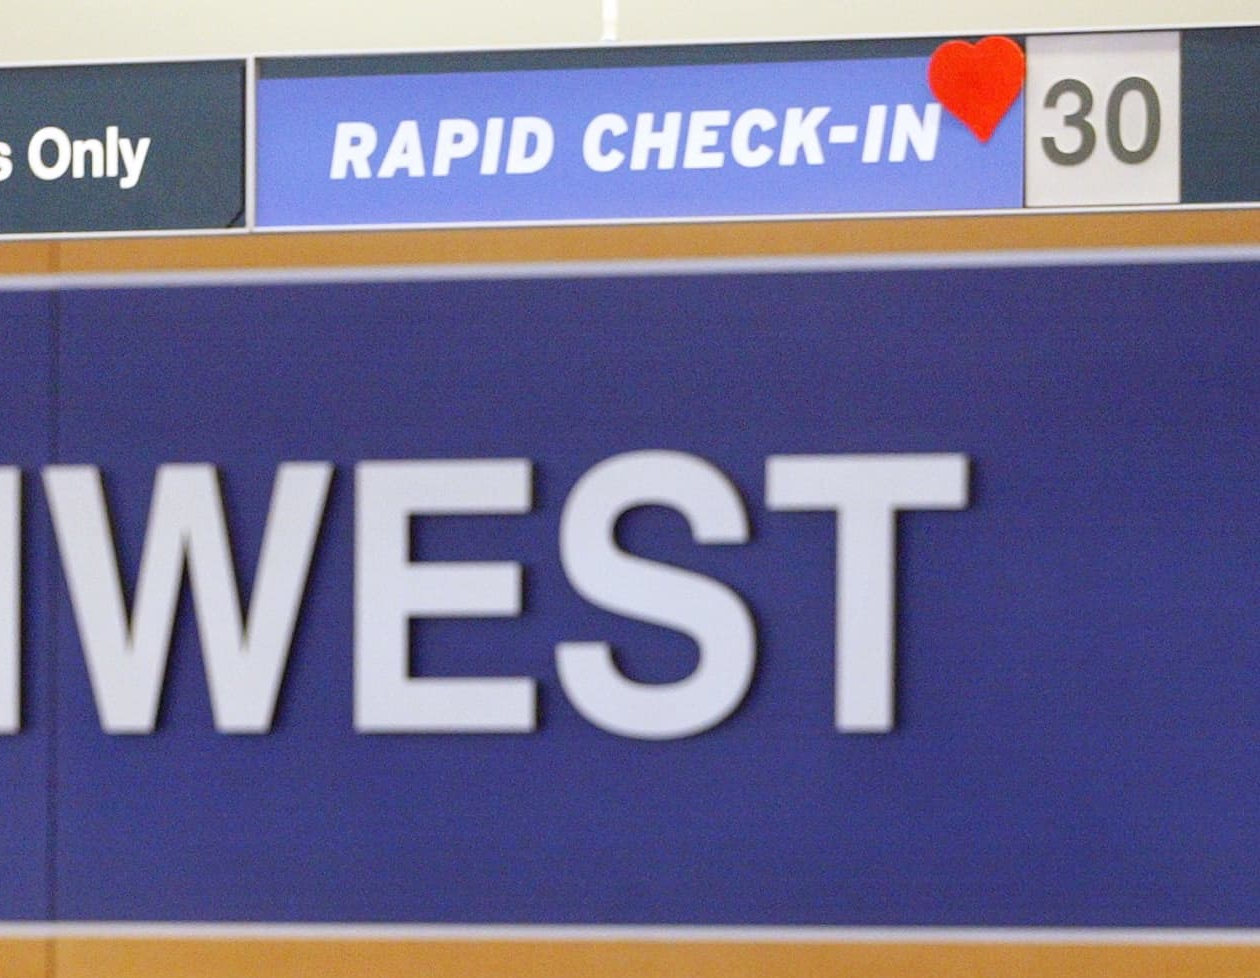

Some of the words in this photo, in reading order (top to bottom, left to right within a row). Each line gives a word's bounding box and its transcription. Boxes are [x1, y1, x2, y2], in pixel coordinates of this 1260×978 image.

[27, 125, 151, 190] Only
[329, 116, 555, 180] RAPID
[582, 103, 940, 173] CHECK-IN
[1041, 76, 1161, 168] 30
